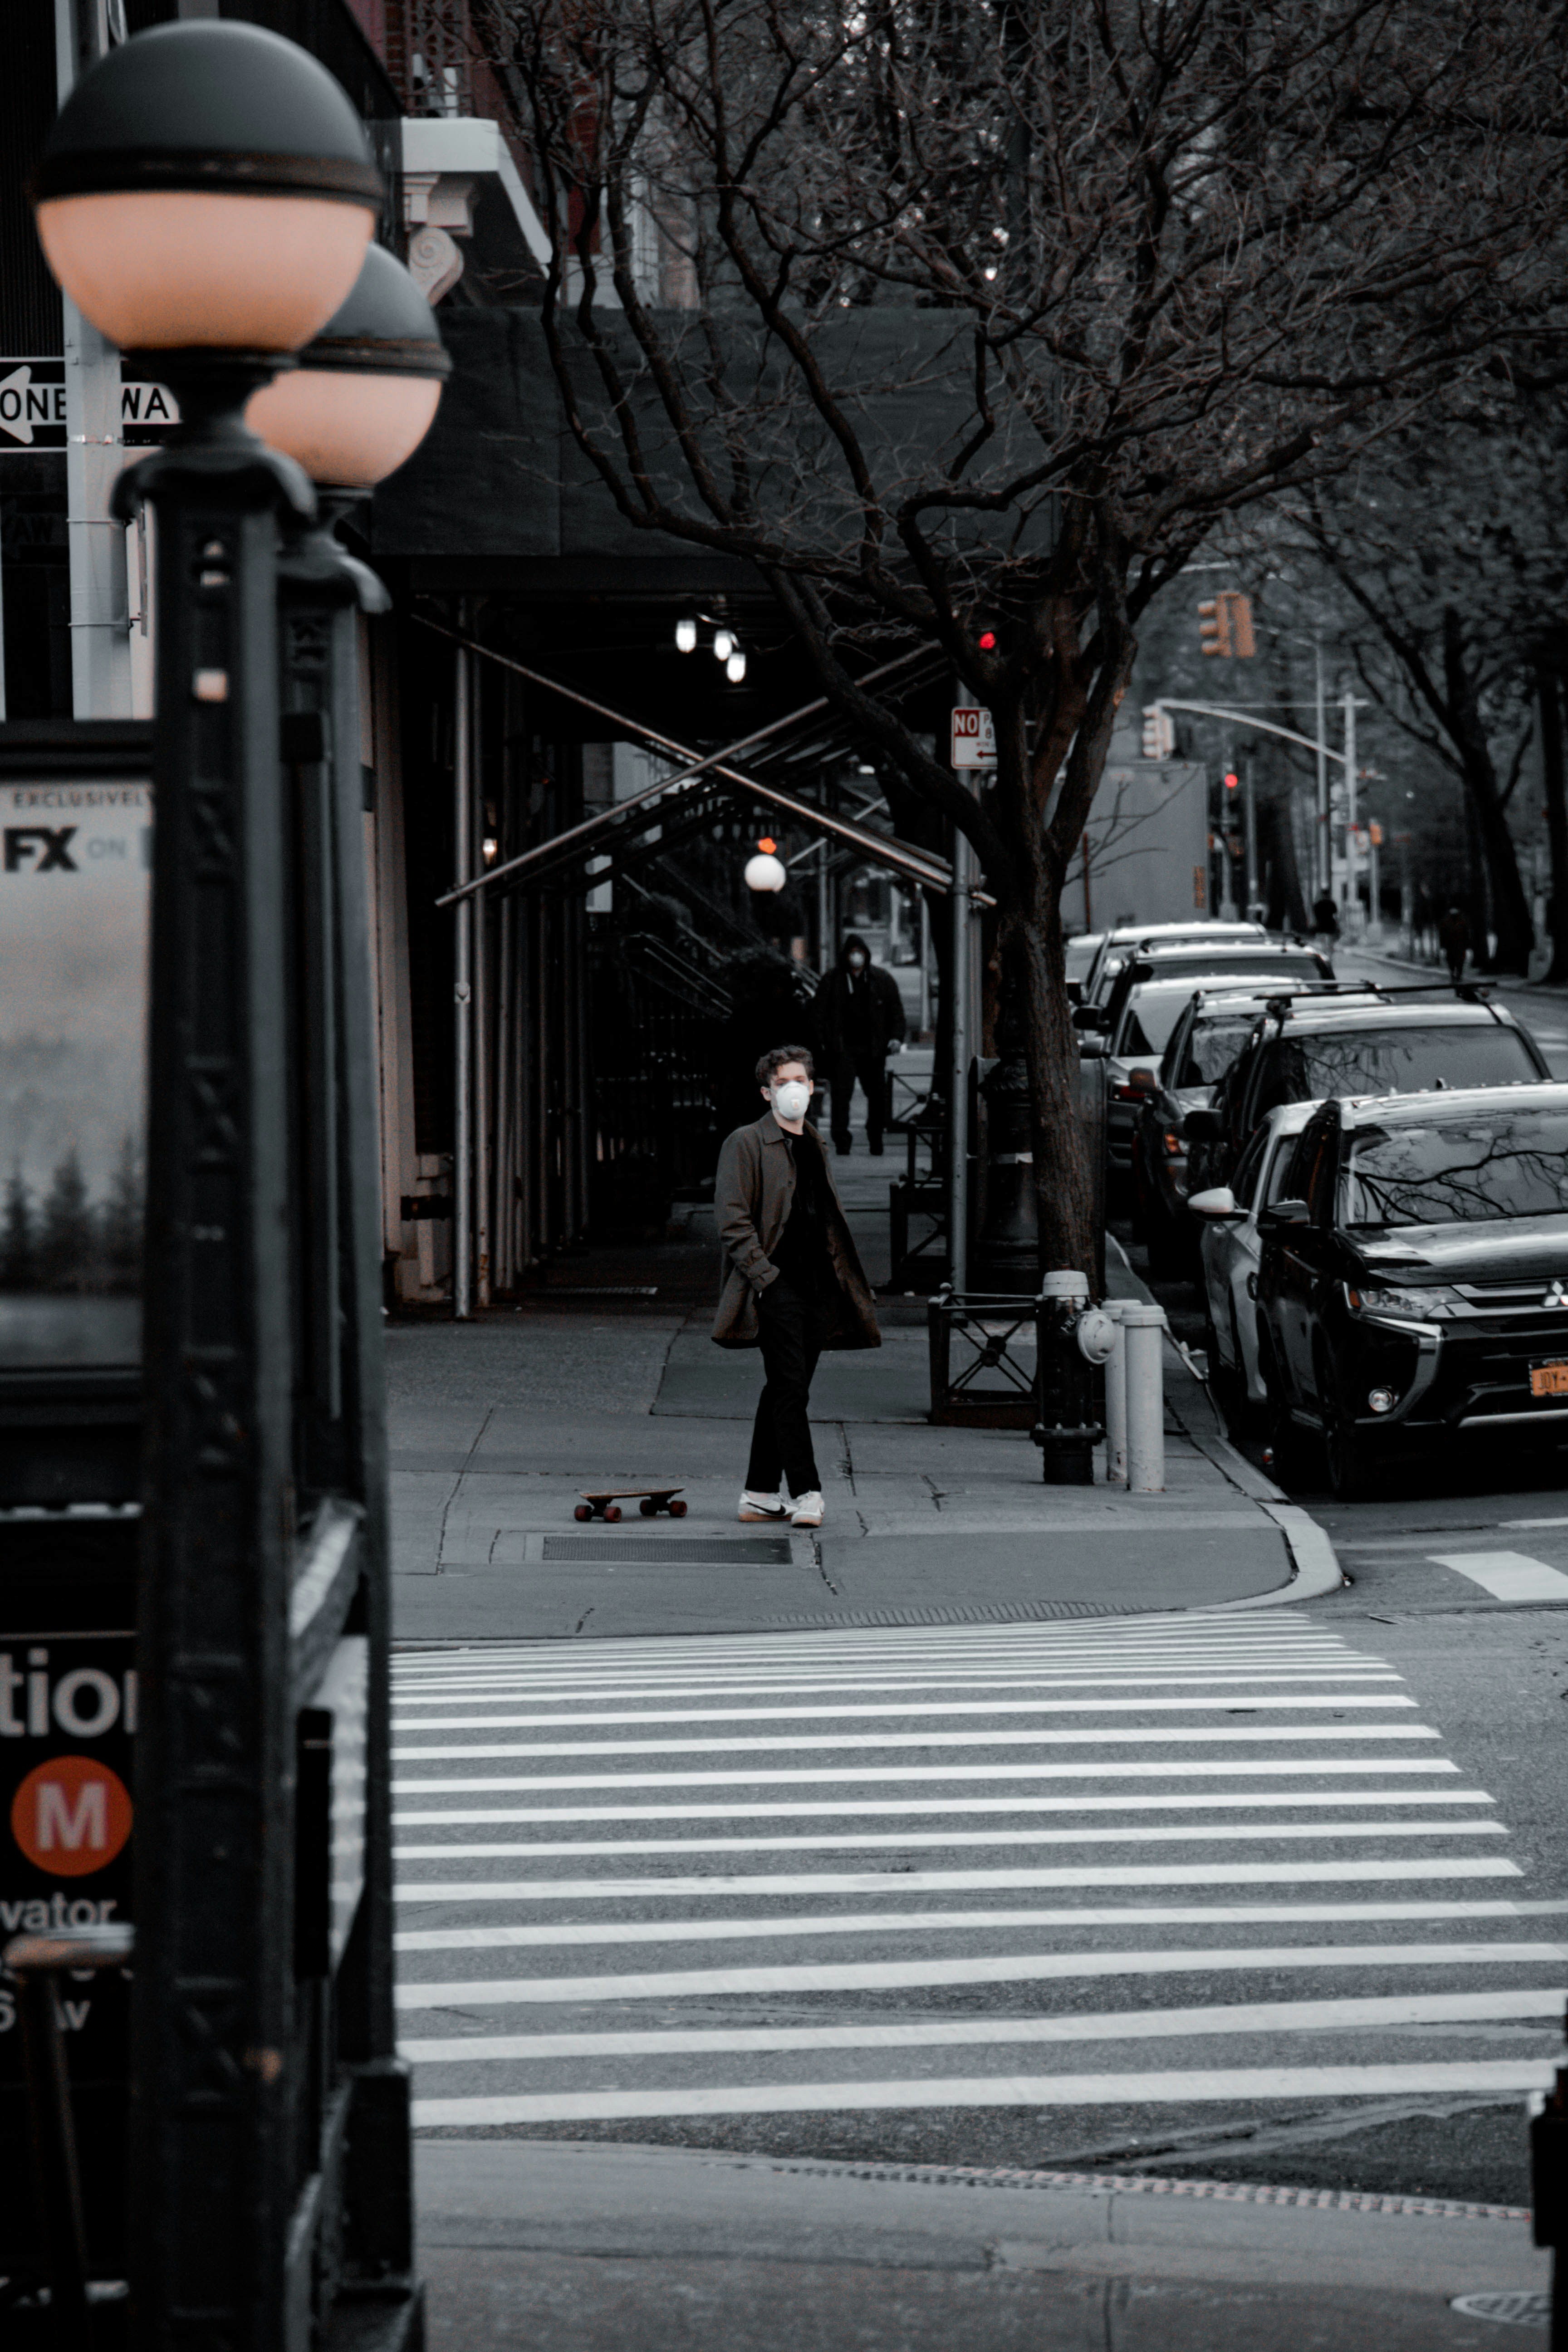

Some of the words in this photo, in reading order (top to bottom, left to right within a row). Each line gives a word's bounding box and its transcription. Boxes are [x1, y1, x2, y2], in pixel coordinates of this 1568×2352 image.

[0, 388, 66, 421] ONE
[122, 387, 170, 419] WA
[955, 713, 978, 734] NO
[4, 826, 78, 872] FX
[36, 1781, 106, 1850] M
[0, 1891, 117, 1931] vator
